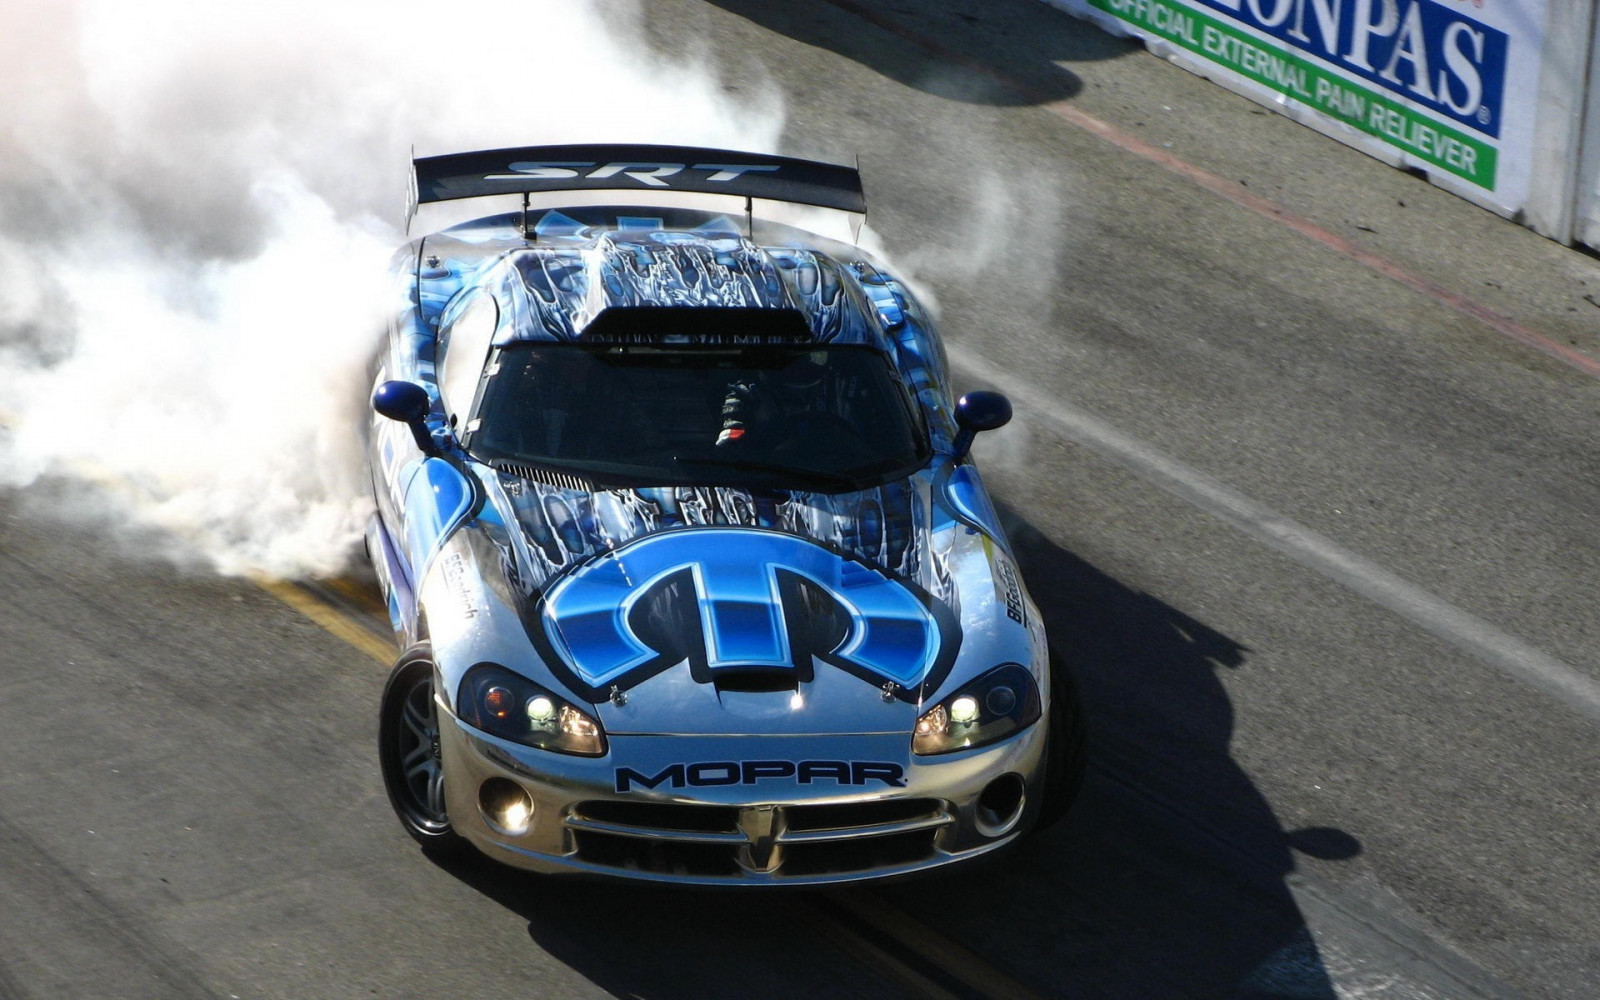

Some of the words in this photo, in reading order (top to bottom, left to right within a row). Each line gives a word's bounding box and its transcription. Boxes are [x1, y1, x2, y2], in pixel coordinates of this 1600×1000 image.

[1213, 0, 1485, 116] NPAS
[1202, 26, 1312, 98] EXTERNAL
[1315, 78, 1365, 126] PAIN
[1369, 98, 1478, 176] RELIEVER
[483, 162, 780, 187] SRT
[614, 759, 906, 793] MOPAR
